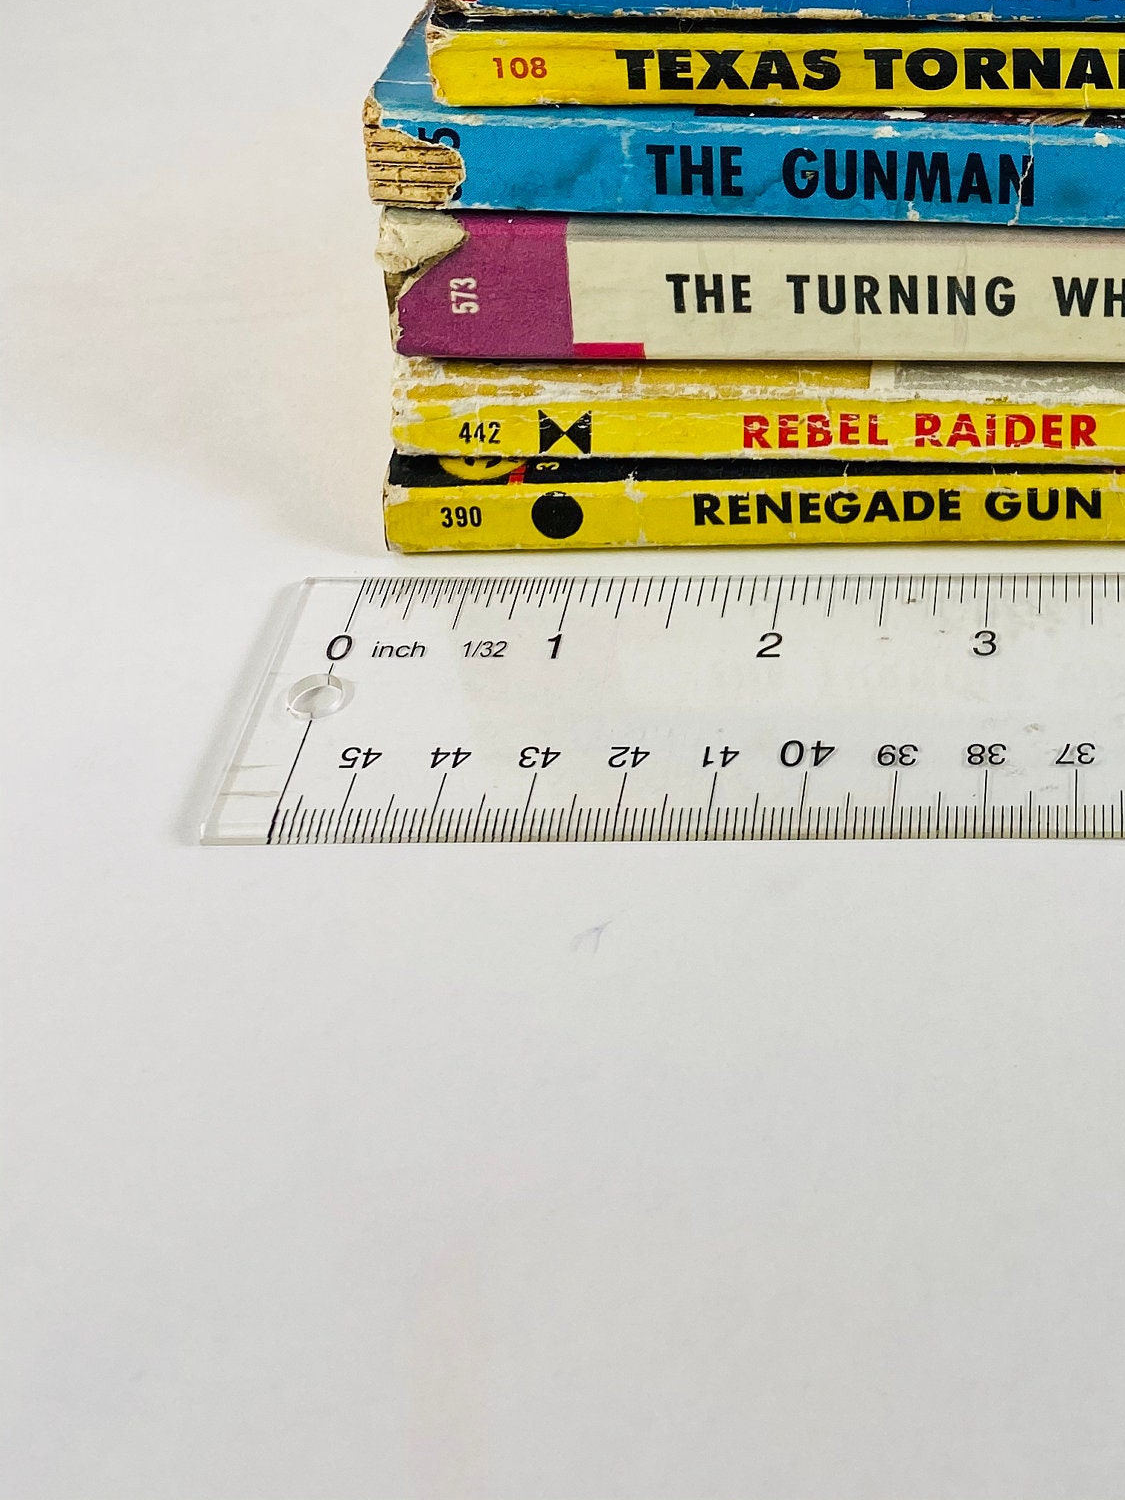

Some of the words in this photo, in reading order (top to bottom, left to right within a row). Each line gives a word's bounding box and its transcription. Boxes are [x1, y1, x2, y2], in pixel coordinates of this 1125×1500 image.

[492, 56, 549, 80] 108
[614, 47, 842, 91] TEXAS
[645, 144, 745, 198] THE
[782, 146, 1036, 209] GUNMAN
[449, 276, 480, 315] 573
[664, 271, 752, 316] THE
[785, 273, 1017, 317] TURNING
[458, 421, 502, 445] 442
[741, 411, 890, 450] REBEL
[913, 412, 1098, 450] RAIDER
[439, 505, 483, 529] 390
[693, 489, 962, 527] RENEGADE
[984, 487, 1102, 522] GUN
[325, 634, 353, 661] 0
[371, 639, 427, 660] inch
[462, 640, 509, 659] 1/32
[547, 633, 563, 660] 1
[756, 632, 783, 658] 2
[972, 630, 998, 657] 3
[337, 746, 384, 770] 45
[429, 747, 473, 769] 44
[517, 746, 562, 769] 43
[607, 746, 651, 769] 42
[701, 745, 741, 768] 41
[779, 740, 837, 768] 40
[876, 744, 920, 767] 39
[966, 743, 1008, 766] 38
[1055, 742, 1097, 765] 37
